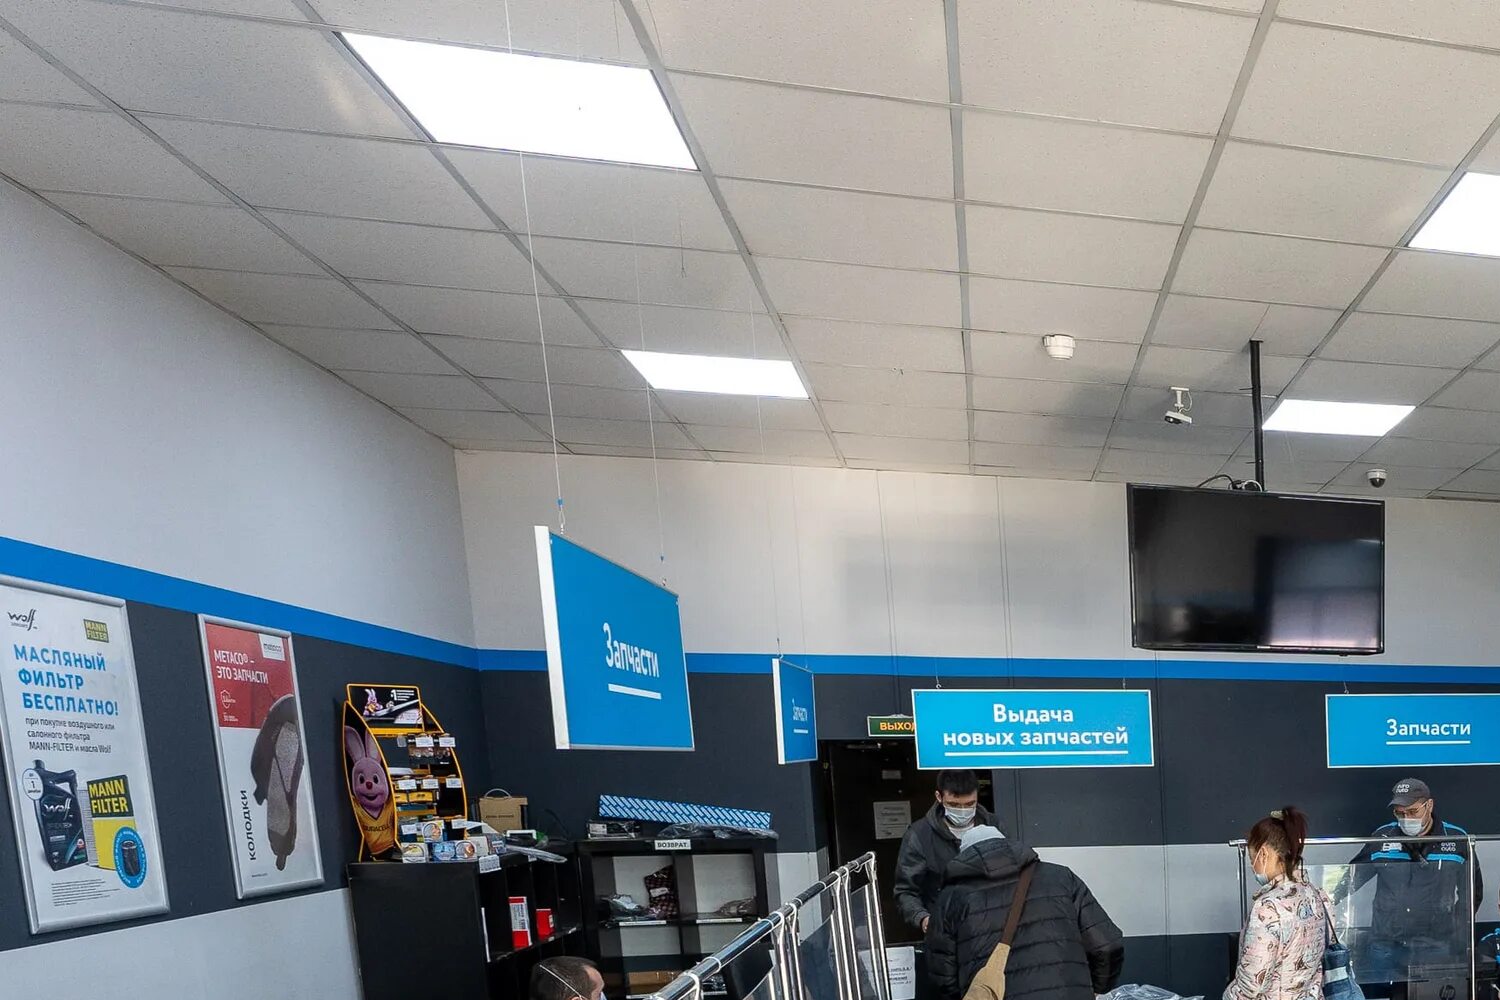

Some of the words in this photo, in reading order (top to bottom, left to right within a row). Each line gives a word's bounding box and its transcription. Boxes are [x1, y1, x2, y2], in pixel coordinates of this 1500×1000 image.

[14, 644, 106, 671] МАСЛЯНЫЙ
[603, 622, 660, 678] Запчасти
[18, 668, 84, 690] ФИЛЬТР
[216, 666, 232, 679] ЭТО
[233, 668, 269, 684] ЗАПЧАСТИ
[22, 692, 119, 716] БЕСПЛАТНО!
[993, 703, 1074, 724] Выдача
[25, 717, 39, 727] при
[40, 719, 66, 728] покупке
[68, 721, 104, 730] воздушного
[1386, 718, 1471, 736] Запчасти
[27, 730, 62, 739] салонного
[64, 732, 90, 741] фильтра
[943, 731, 1014, 746] новых
[1020, 727, 1128, 745] запчастей
[29, 742, 74, 751] MANN-FILTER
[88, 779, 125, 798] MANN
[91, 797, 129, 813] FILTER
[240, 790, 256, 860] КОЛОДКИ
[1440, 985, 1456, 1000] hp
